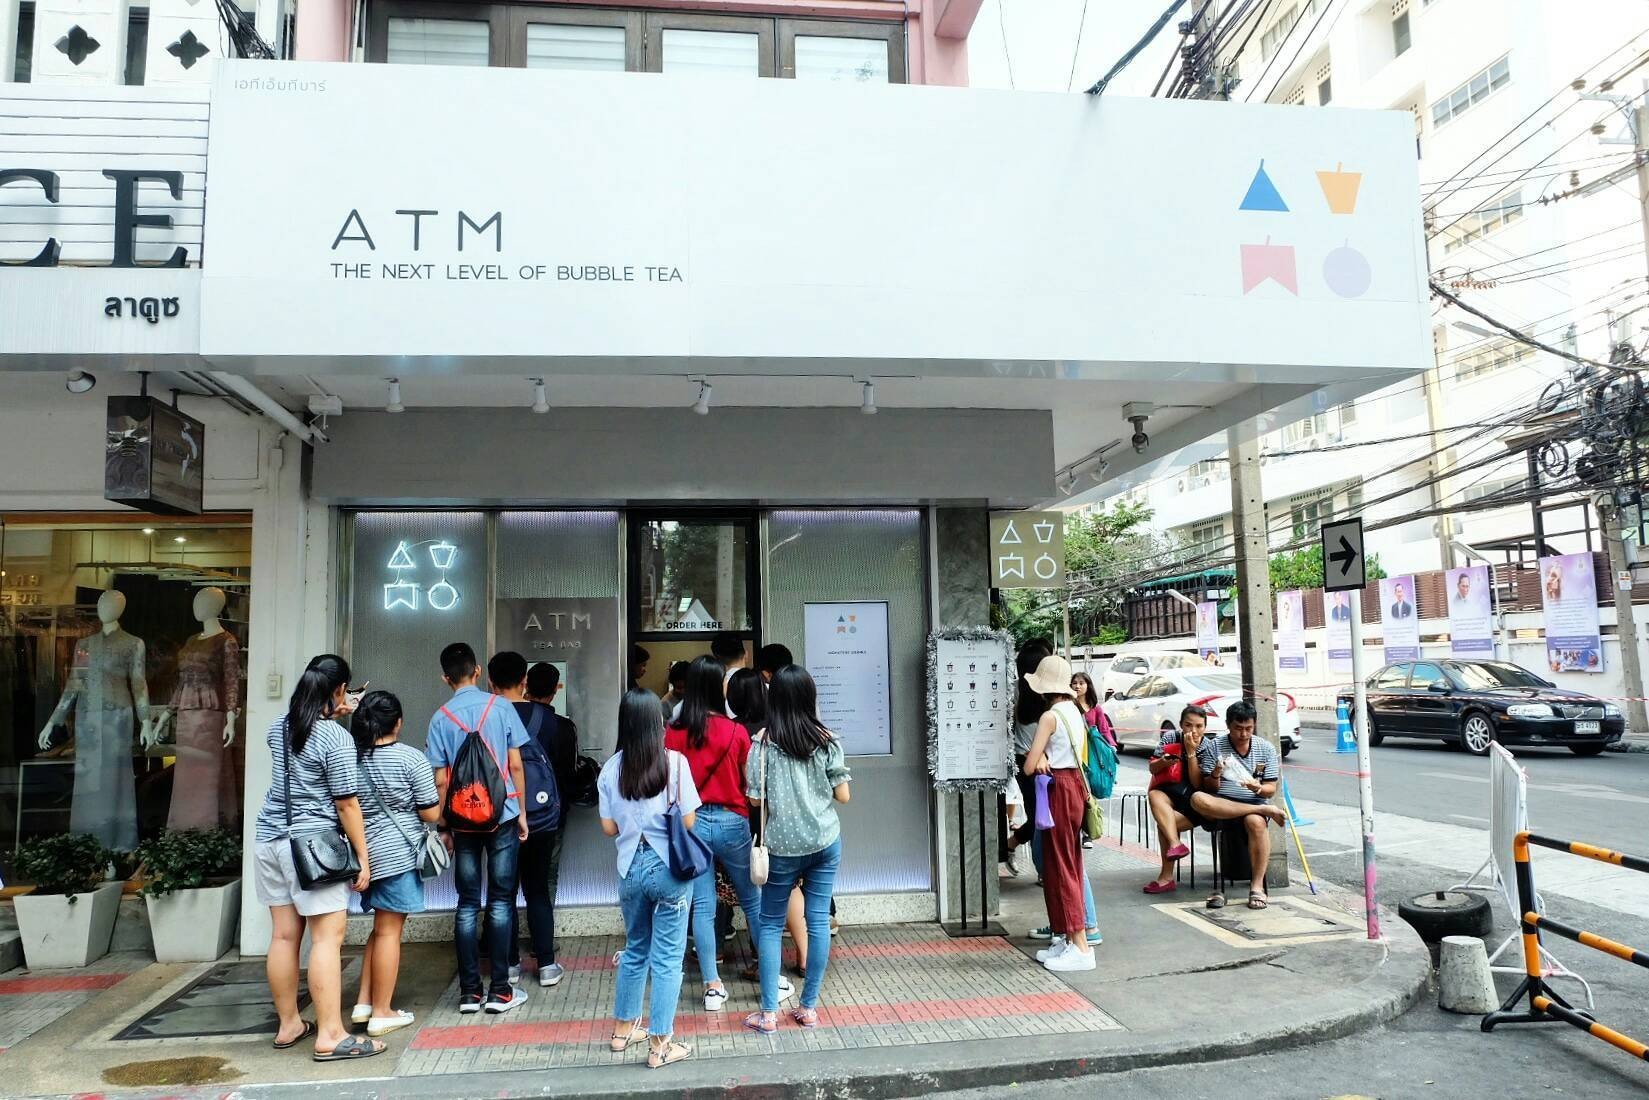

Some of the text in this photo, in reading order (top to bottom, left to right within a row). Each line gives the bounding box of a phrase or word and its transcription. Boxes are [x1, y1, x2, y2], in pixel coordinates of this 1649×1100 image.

[331, 208, 502, 252] ATM
[330, 262, 684, 282] THE NEXT LEVEL OF BUBBLE TEA
[524, 612, 591, 631] ATM
[666, 621, 723, 629] ORDER HERE
